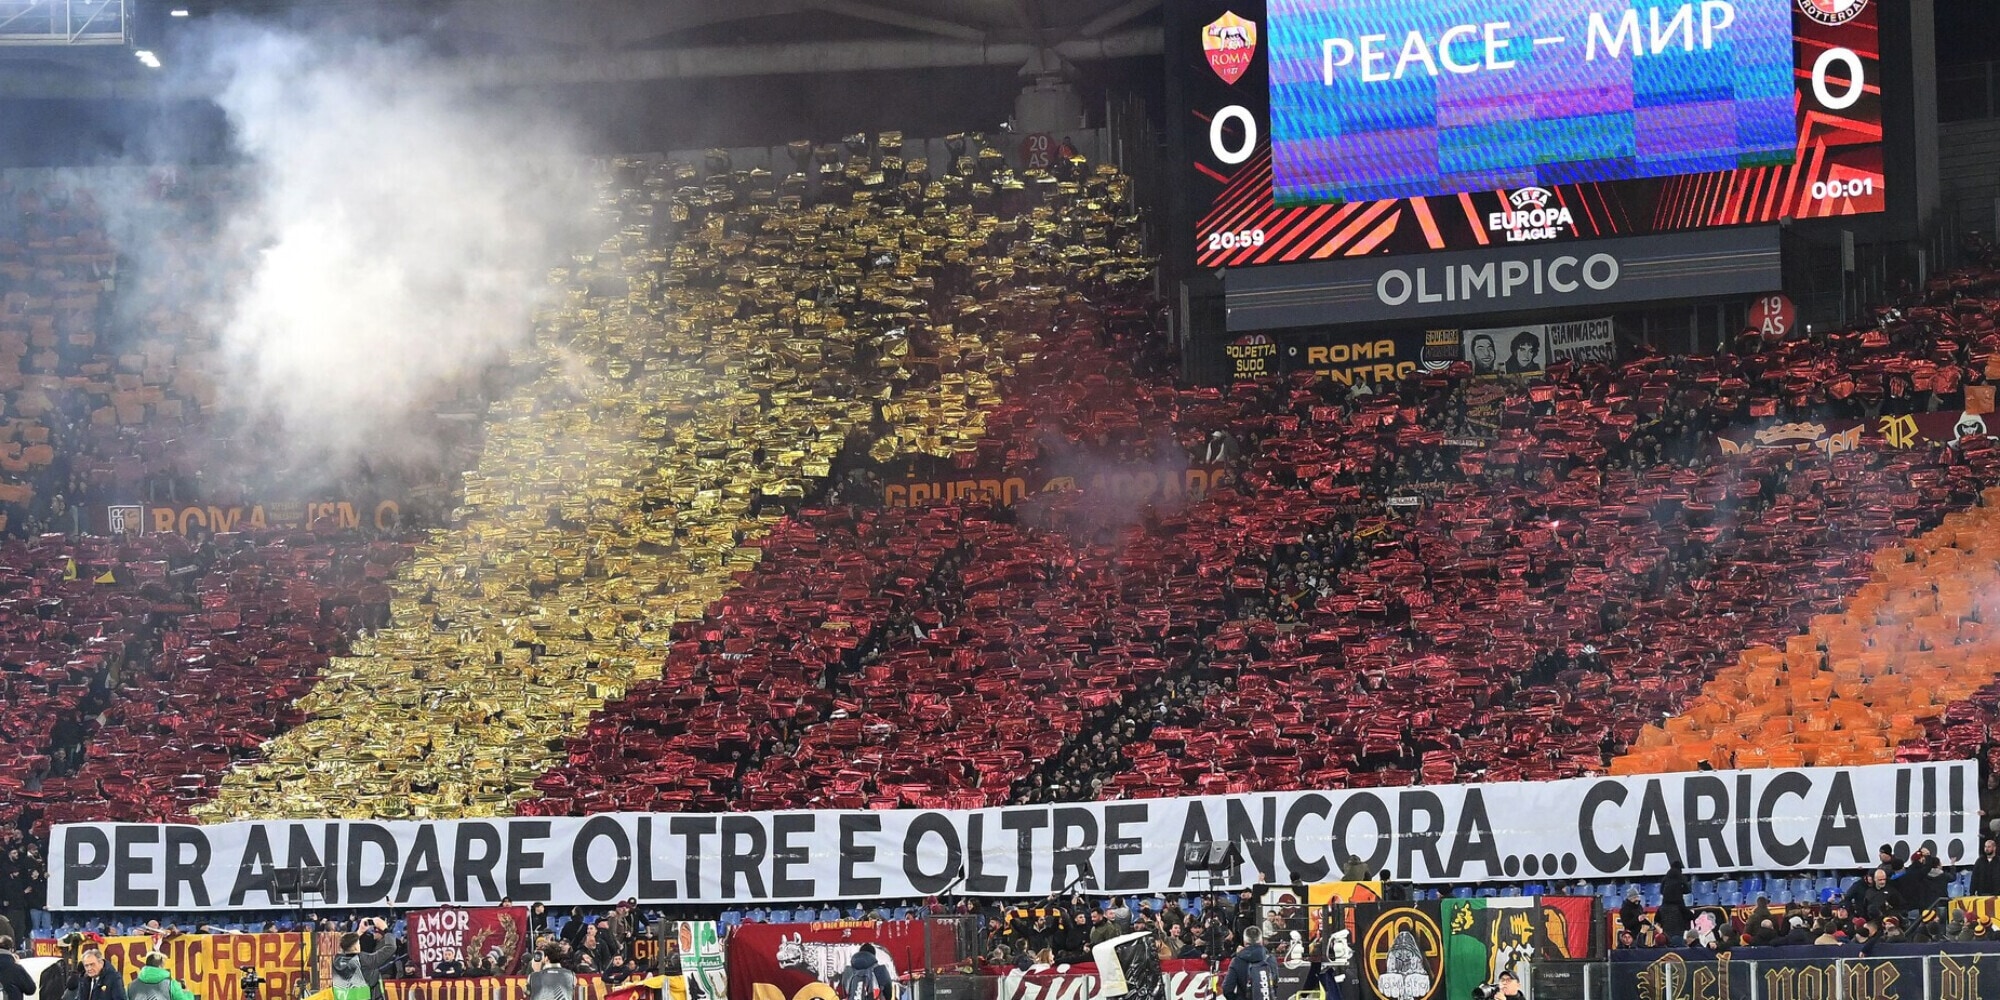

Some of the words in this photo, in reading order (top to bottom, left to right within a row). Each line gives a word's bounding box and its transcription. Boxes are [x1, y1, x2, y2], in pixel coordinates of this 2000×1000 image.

[1323, 21, 1516, 86] PEACE
[1586, 0, 1735, 61] МИР
[1211, 52, 1250, 66] ROMA
[1812, 47, 1865, 110] 0
[1029, 135, 1048, 151] 20
[1210, 105, 1257, 165] 0
[1029, 152, 1049, 168] AS
[1511, 189, 1549, 206] UEFA
[1811, 178, 1873, 200] 00:01
[1489, 206, 1574, 231] EUROPA
[1208, 229, 1265, 250] 20:59
[1506, 227, 1557, 242] LEAGUE
[1376, 253, 1619, 306] OLIMPICO
[1760, 296, 1782, 316] 19
[1761, 316, 1785, 335] AS
[1226, 344, 1277, 358] POLPETTA
[1308, 340, 1395, 364] ROMA
[1236, 358, 1265, 372] SUDO
[63, 825, 212, 907] PER
[228, 821, 552, 907] ANDARE
[572, 813, 816, 902] OLTRE
[839, 813, 882, 897] E
[903, 803, 1149, 894] OLTRE
[417, 910, 469, 933] AMOR
[418, 930, 463, 950] ROMAE
[212, 934, 312, 969] FORZ
